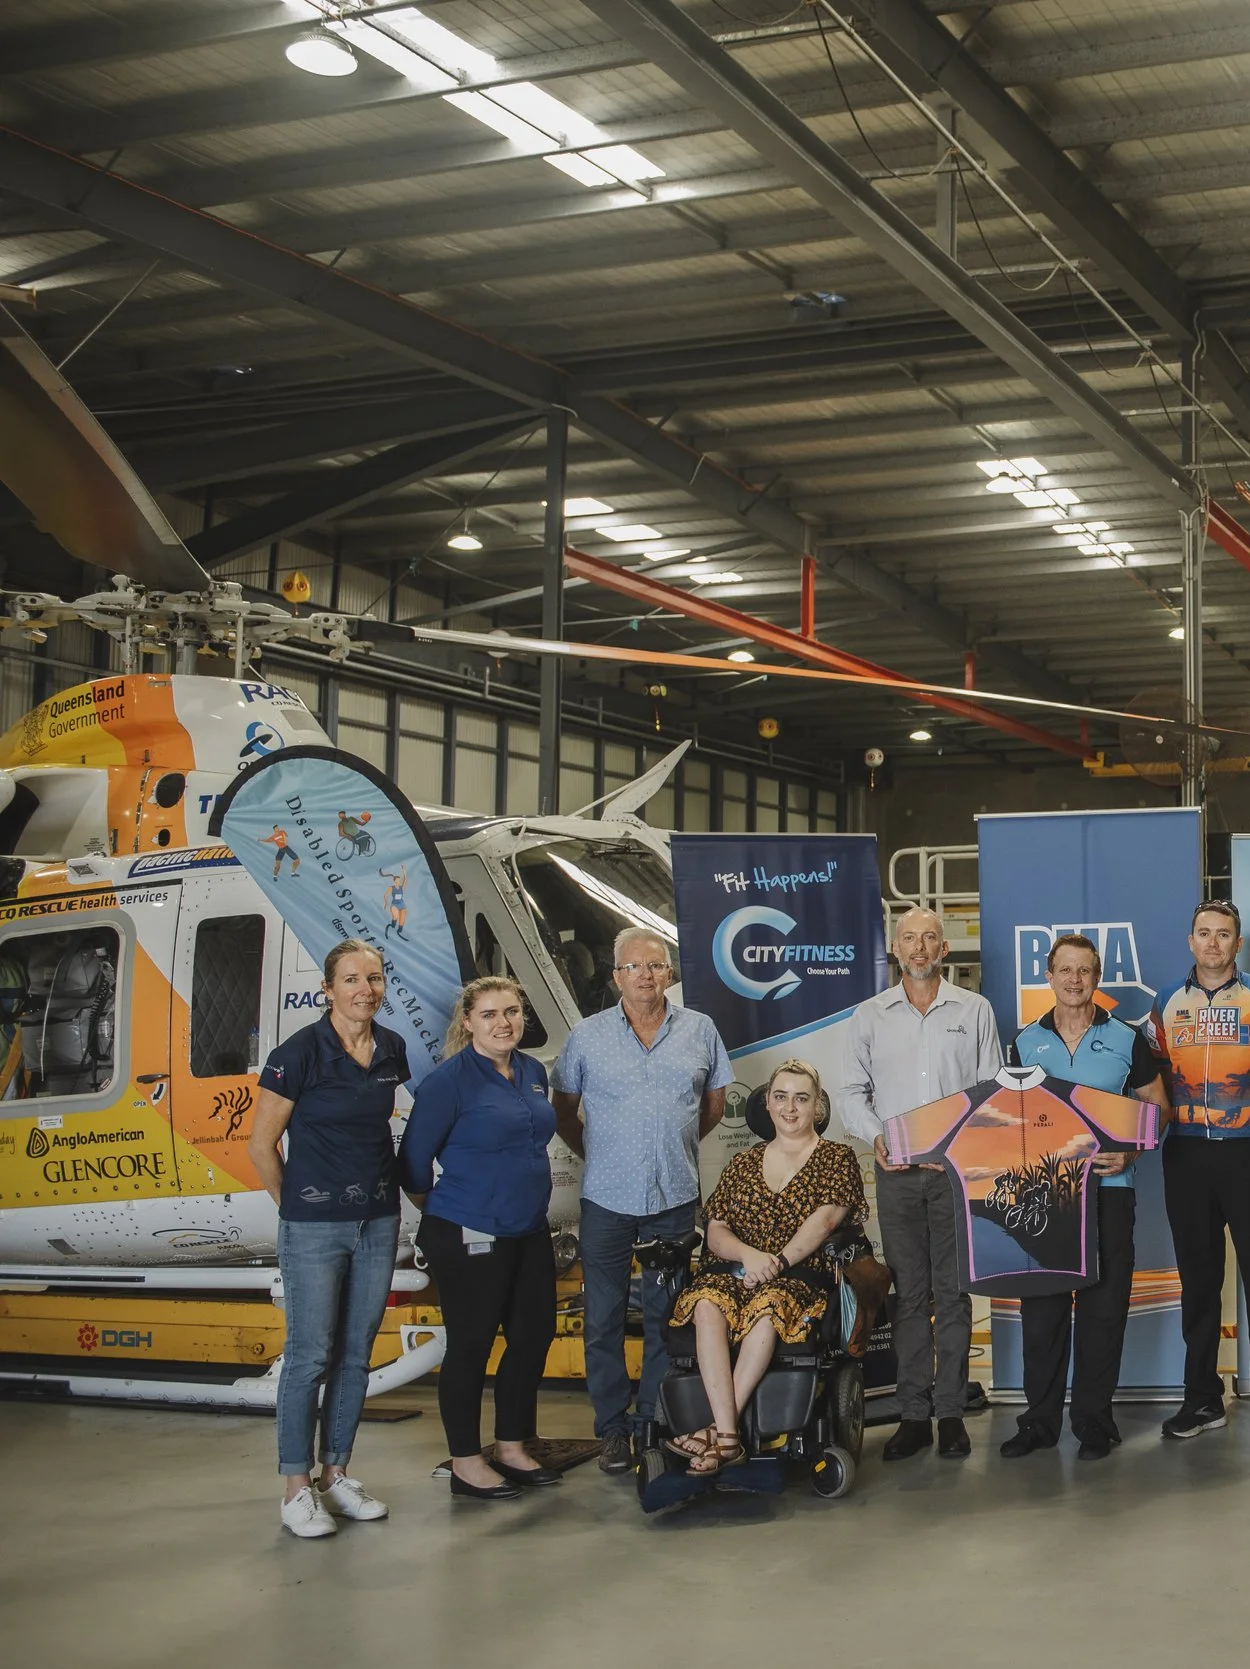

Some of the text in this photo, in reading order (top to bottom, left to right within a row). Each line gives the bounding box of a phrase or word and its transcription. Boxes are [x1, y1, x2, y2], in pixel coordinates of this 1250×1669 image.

[50, 680, 125, 718] Queensland
[49, 703, 125, 738] Government
[286, 795, 344, 885] Disabled
[18, 900, 78, 917] RESCUE
[79, 895, 117, 910] health
[119, 891, 168, 905] services
[742, 945, 855, 962] CITYFITNESS
[1016, 923, 1142, 987] BA
[807, 967, 850, 975] Choose Your Path
[284, 991, 330, 1010] RAC
[1199, 1008, 1235, 1022] RIVER
[1206, 1022, 1236, 1036] REEF
[52, 1128, 145, 1149] AngloAmerican
[191, 1135, 225, 1145] Jellinbah
[43, 1152, 166, 1184] GLENCORE
[101, 1329, 152, 1348] DGH
